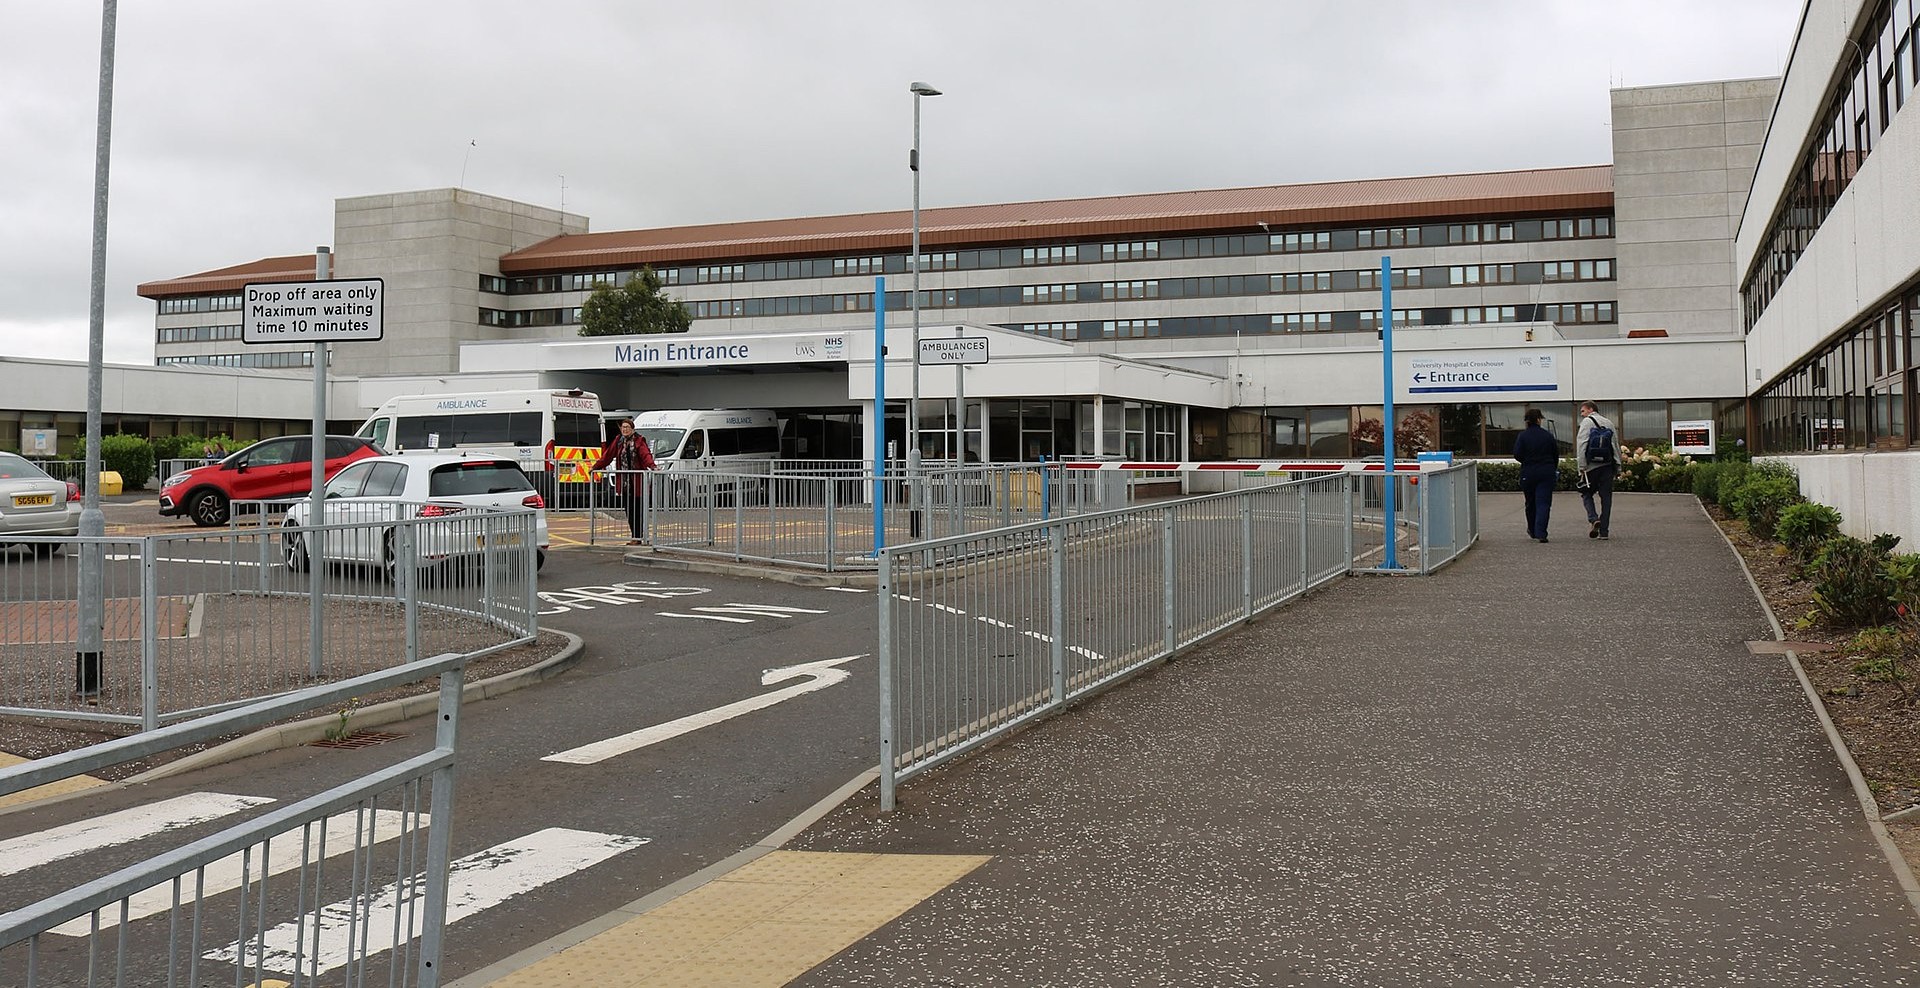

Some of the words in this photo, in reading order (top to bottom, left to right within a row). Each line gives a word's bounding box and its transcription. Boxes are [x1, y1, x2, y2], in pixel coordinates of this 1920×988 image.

[249, 289, 281, 303] Drop
[287, 287, 307, 301] off
[312, 289, 342, 300] area
[347, 285, 377, 301] only
[252, 304, 317, 318] Maximum
[323, 302, 373, 317] waiting
[256, 320, 286, 334] time
[292, 320, 308, 333] 10
[314, 319, 369, 332] minutes
[825, 337, 843, 346] NHS
[921, 341, 985, 351] AMBULANCES
[614, 344, 660, 363] Main
[666, 342, 749, 361] Entrance
[795, 346, 816, 358] UWS
[940, 352, 965, 360] ONLY
[1412, 361, 1442, 370] University
[1443, 361, 1469, 369] Hospital
[1469, 360, 1504, 368] Crosshouse
[1430, 370, 1490, 383] Entrance
[437, 399, 488, 410] AMBULANCE
[557, 398, 594, 410] AMBULANCE
[725, 416, 753, 425] AMBULANCE
[17, 497, 36, 505] SG56
